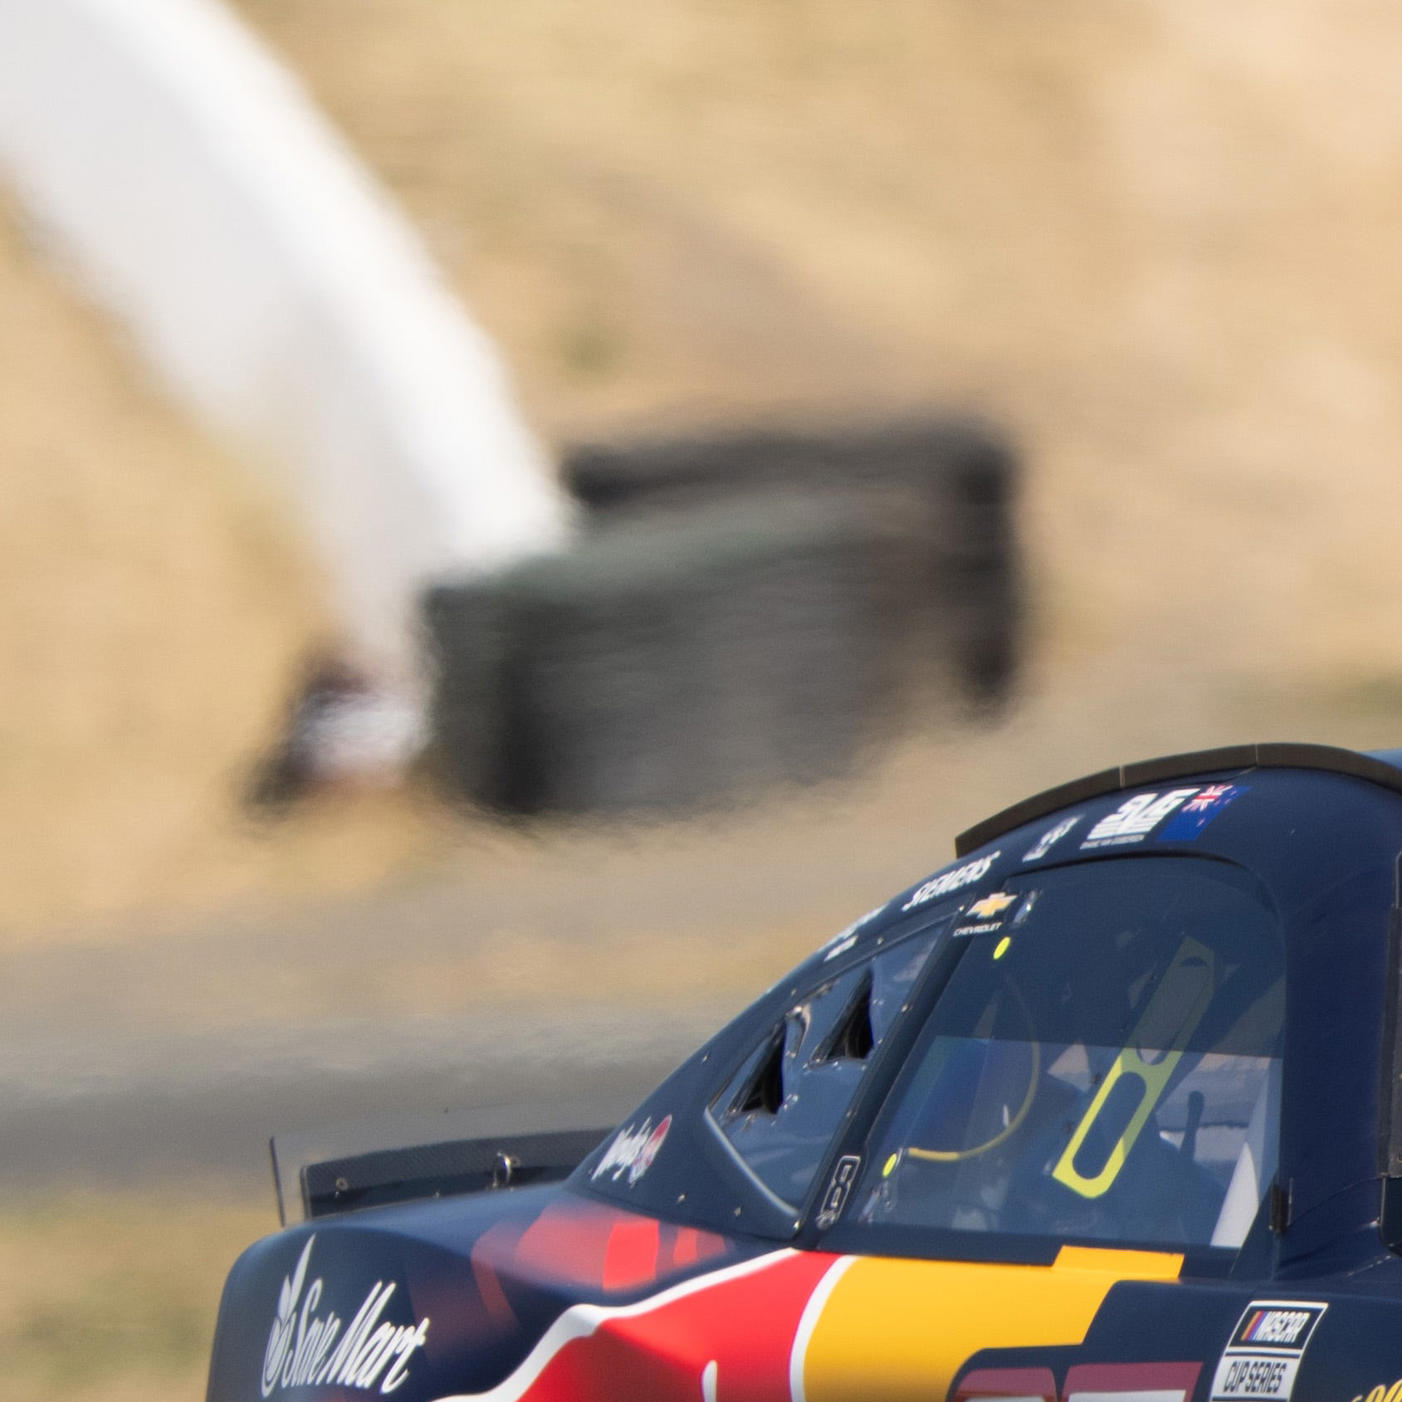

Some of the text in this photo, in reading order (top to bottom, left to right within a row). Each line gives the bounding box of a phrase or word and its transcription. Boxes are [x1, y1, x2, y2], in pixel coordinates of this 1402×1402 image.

[1252, 1311, 1312, 1343] NASCAR
[1223, 1361, 1288, 1394] CUP SERIES
